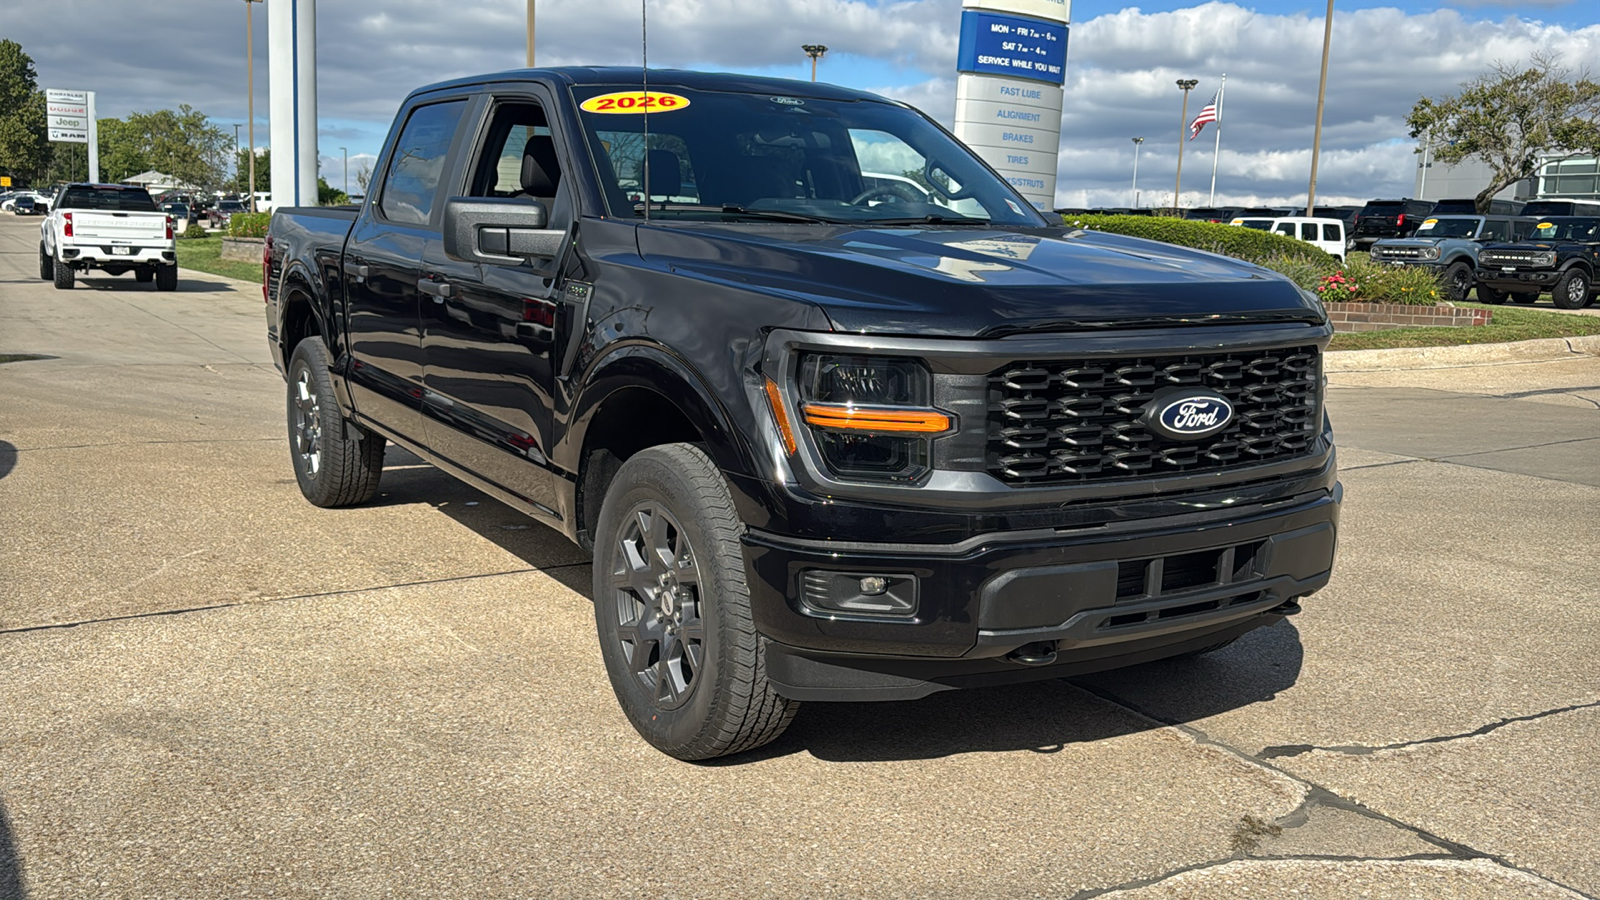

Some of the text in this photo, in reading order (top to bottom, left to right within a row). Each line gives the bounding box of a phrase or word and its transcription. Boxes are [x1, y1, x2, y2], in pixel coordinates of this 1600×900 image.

[991, 24, 1009, 34] MON
[1017, 27, 1028, 36] FRI
[1002, 42, 1016, 51] SAT
[978, 55, 1061, 74] SERVICE WHILE YOU WAIT
[1000, 86, 1041, 100] FAST LUBE
[596, 96, 677, 111] 2026
[997, 110, 1040, 122] ALIGNMENT
[56, 118, 80, 128] Jeep
[1002, 132, 1034, 144] BRAKES
[1007, 155, 1029, 166] TIRES
[1174, 402, 1219, 428] Ford
